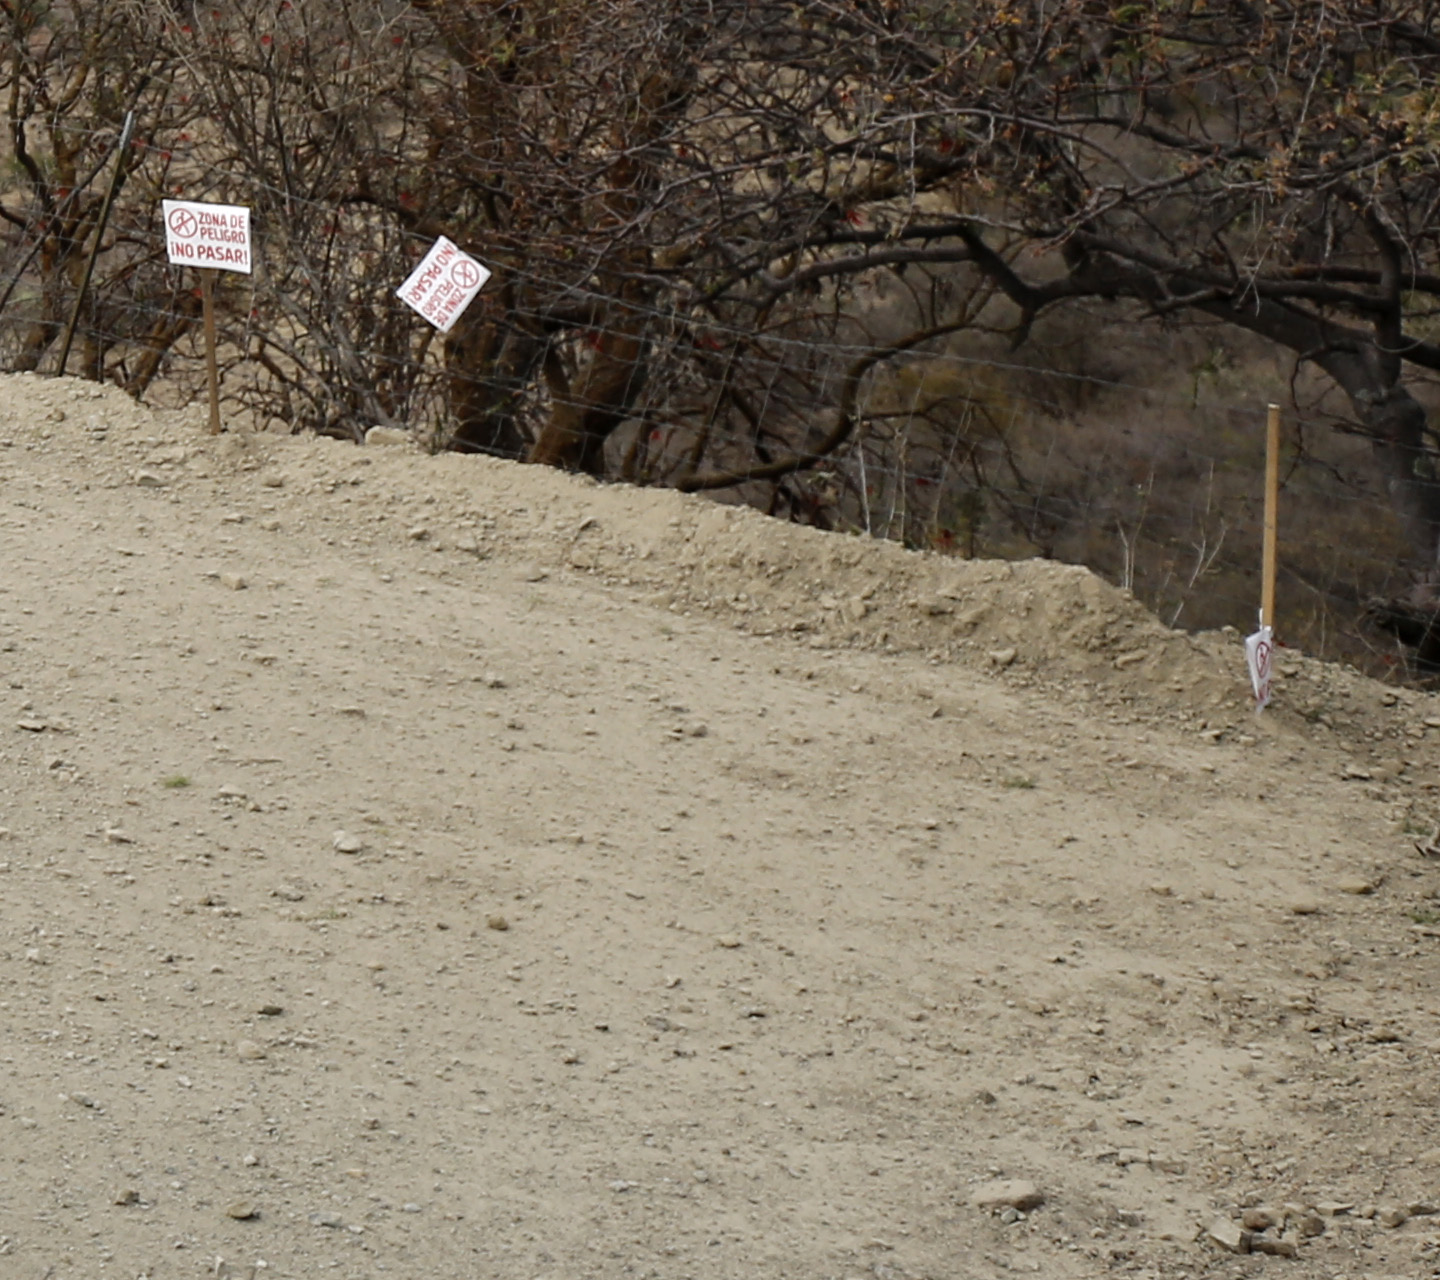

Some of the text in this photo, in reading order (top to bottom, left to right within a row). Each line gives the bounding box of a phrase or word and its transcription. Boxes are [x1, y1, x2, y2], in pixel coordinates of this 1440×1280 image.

[198, 211, 245, 229] ZONA DE
[200, 227, 246, 244] PELIGRO
[170, 241, 248, 265] ¡NO PASAR!
[405, 262, 442, 305] PASAR!
[422, 278, 454, 316] PELIGRO
[442, 288, 467, 313] ZONA
